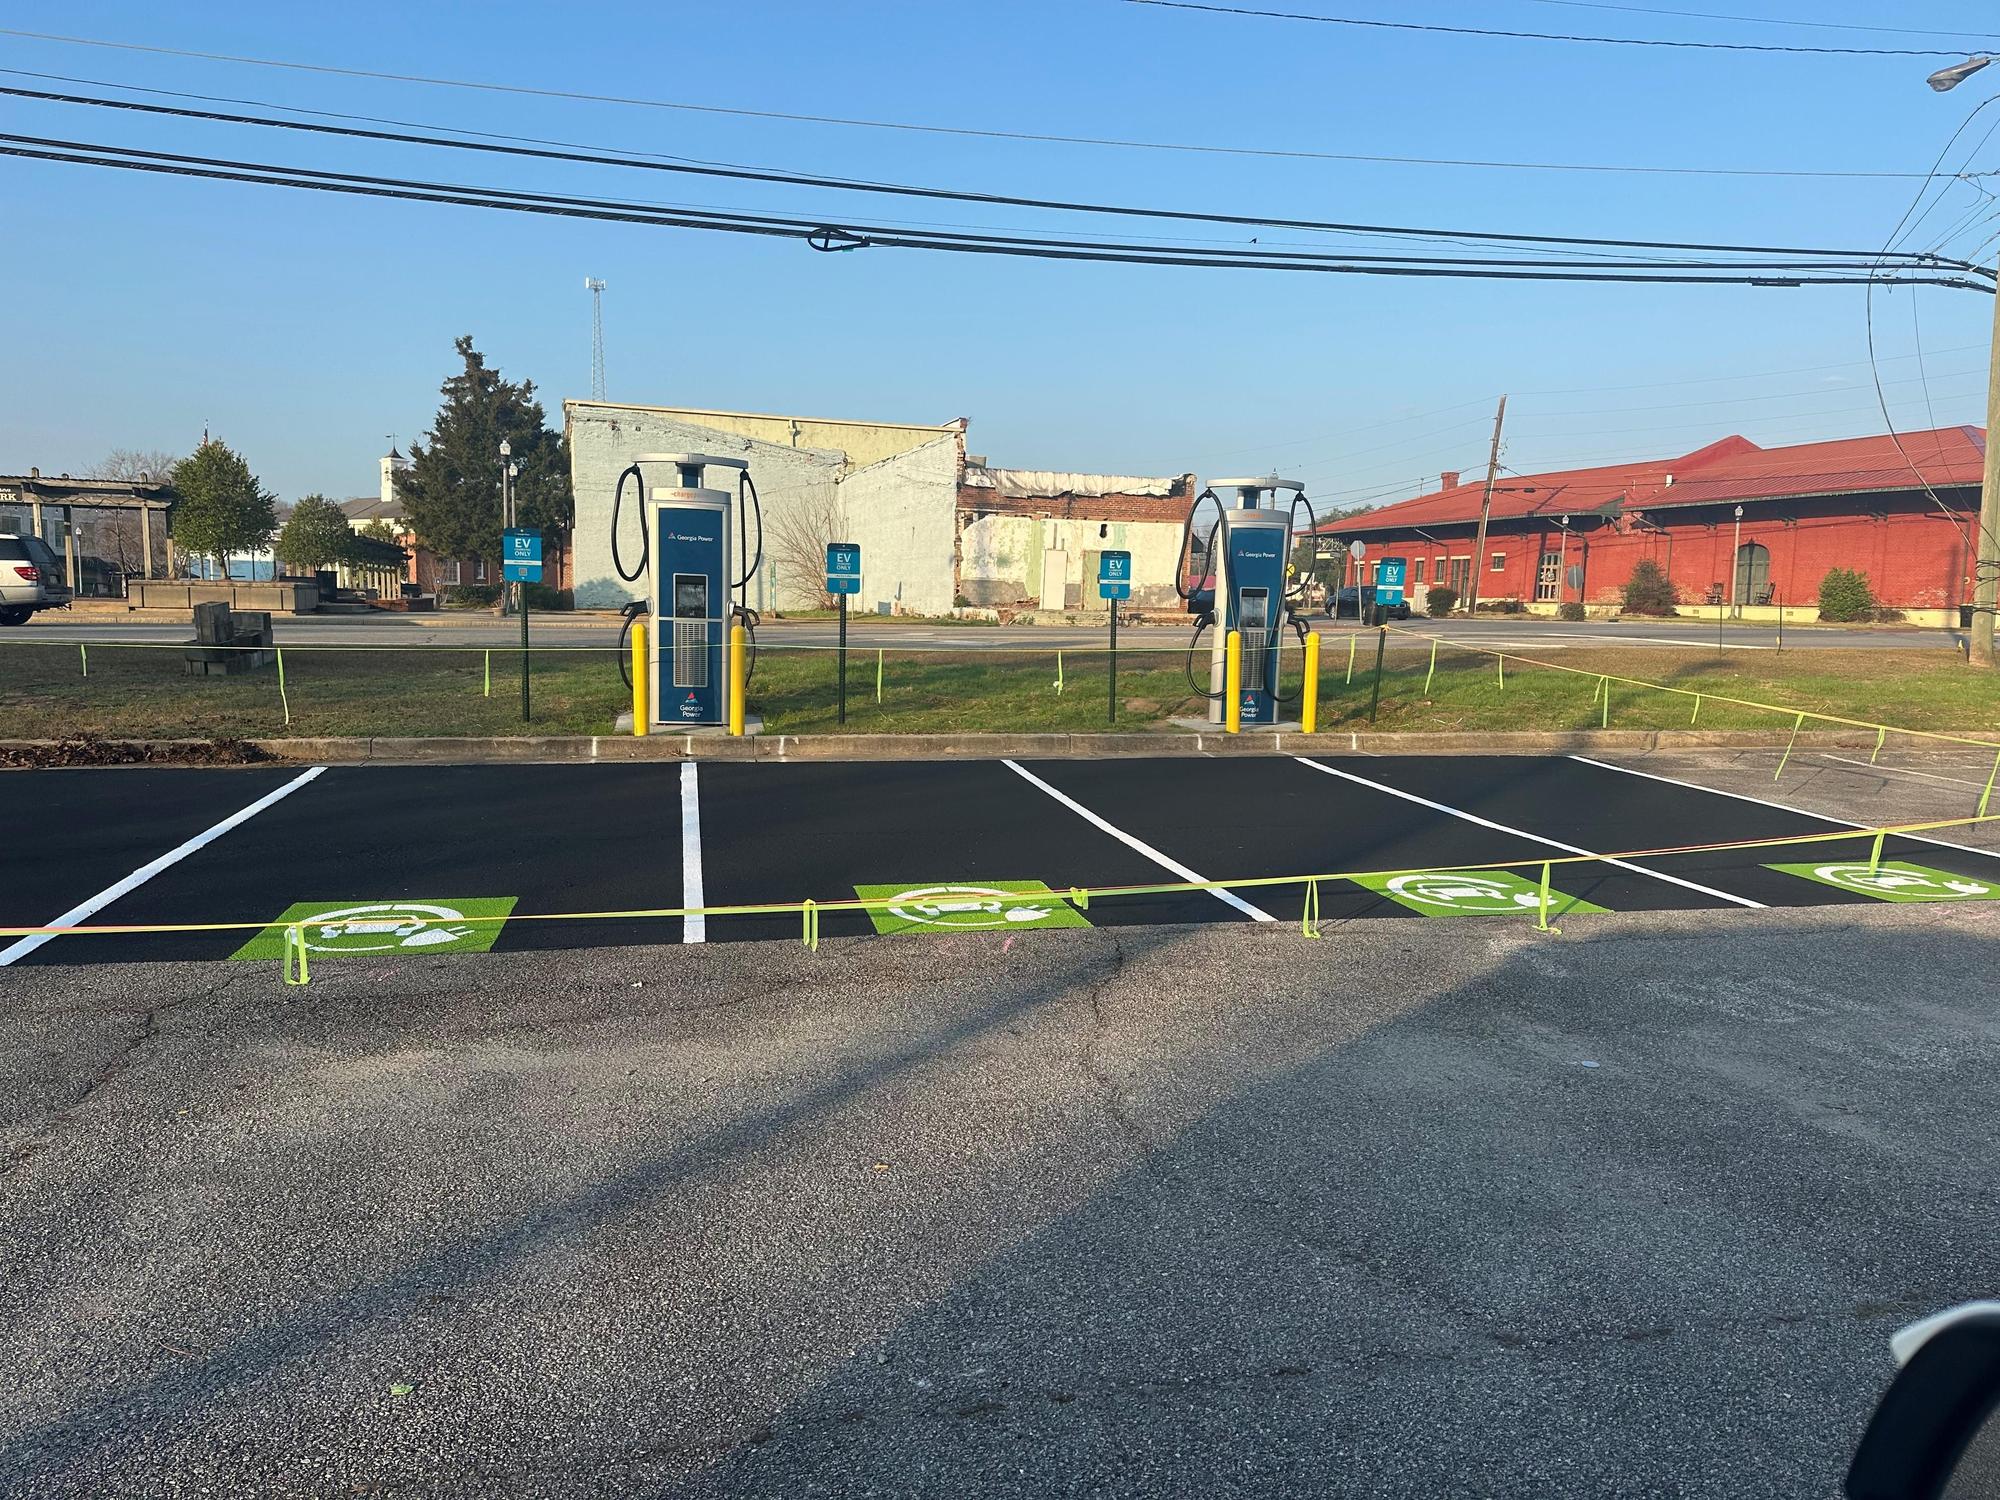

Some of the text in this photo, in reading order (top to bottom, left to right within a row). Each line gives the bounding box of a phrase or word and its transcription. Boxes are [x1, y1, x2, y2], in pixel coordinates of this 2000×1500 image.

[515, 538, 531, 548] EV
[837, 553, 851, 562] EV
[1109, 560, 1123, 569] EV
[1387, 566, 1400, 575] EV
[680, 704, 704, 712] Georgia
